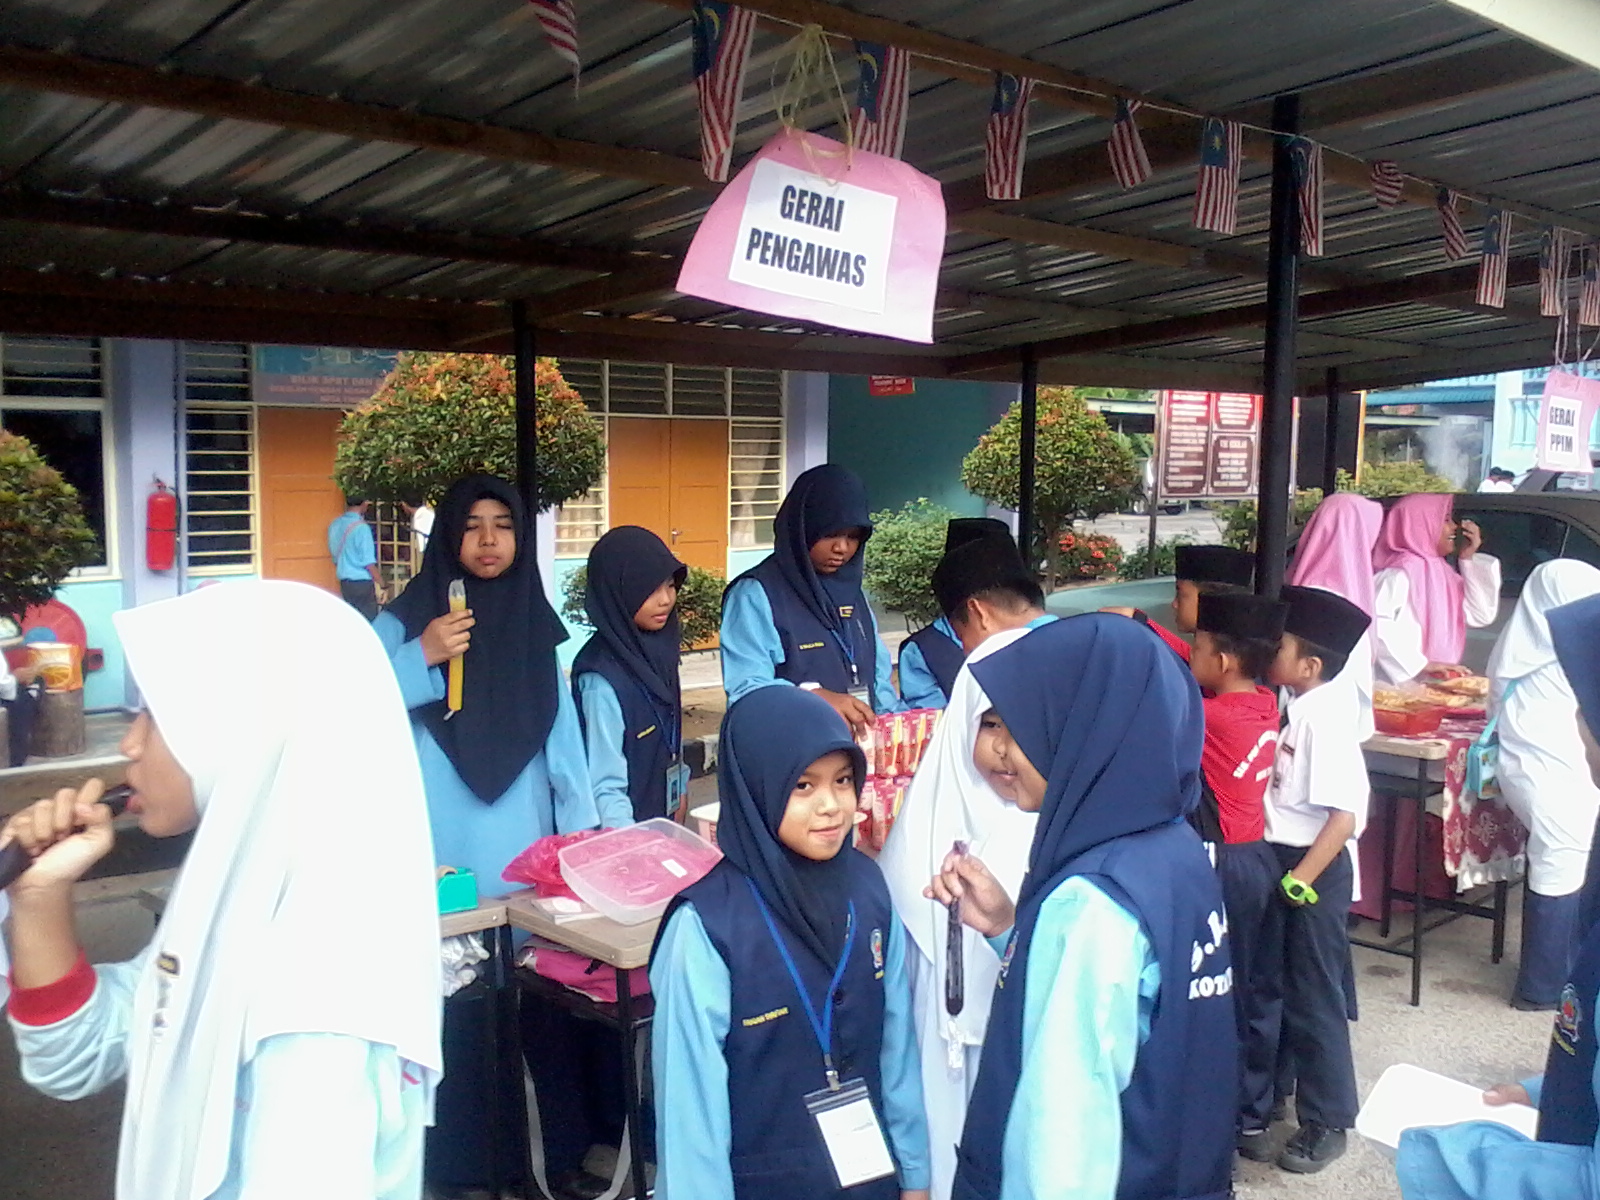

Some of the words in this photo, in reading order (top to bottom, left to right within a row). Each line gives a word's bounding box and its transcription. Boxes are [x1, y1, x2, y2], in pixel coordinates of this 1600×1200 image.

[780, 185, 844, 232] GERAI
[745, 227, 866, 287] PENGAWAS
[1549, 406, 1575, 427] GERAI
[1550, 432, 1573, 453] PPIM
